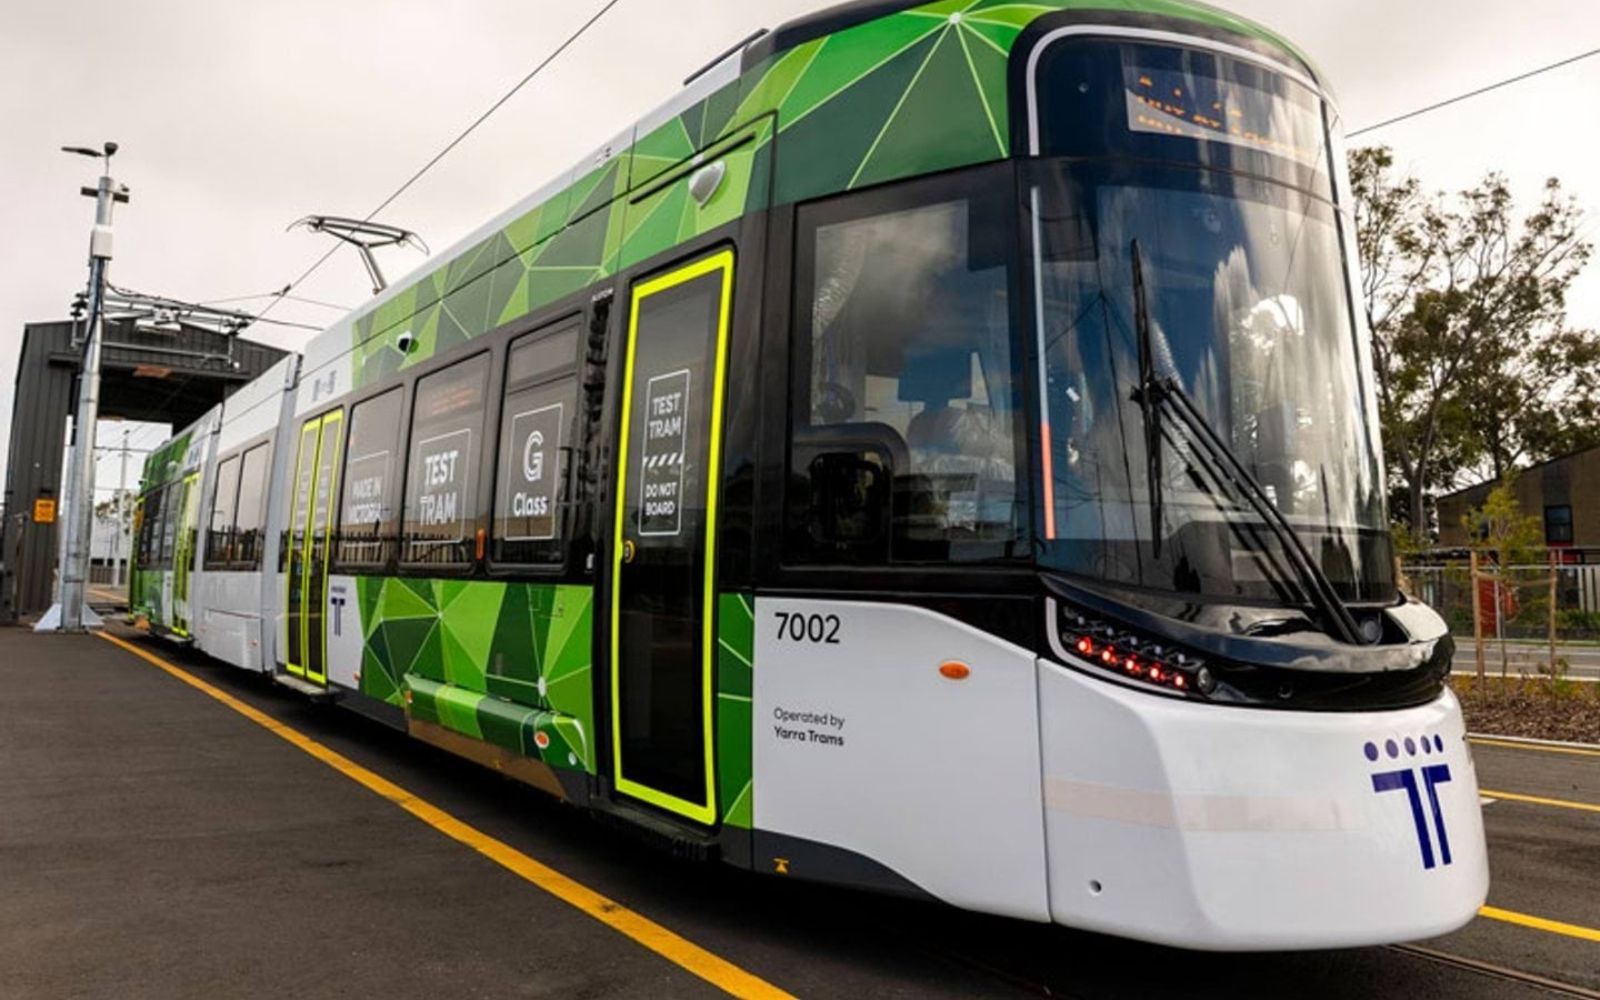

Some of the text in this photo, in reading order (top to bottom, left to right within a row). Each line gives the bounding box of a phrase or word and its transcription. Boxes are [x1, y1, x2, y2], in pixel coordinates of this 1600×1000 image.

[652, 392, 681, 416] TEST
[650, 417, 681, 440] TRAM
[524, 430, 543, 481] G
[425, 450, 458, 486] TEST
[645, 482, 677, 498] DO NOT
[420, 492, 457, 526] TRAM
[514, 492, 547, 517] Class
[645, 501, 675, 516] BOARD
[774, 612, 840, 643] 7002
[774, 707, 845, 730] Operated by
[774, 726, 844, 746] Yarra Trams
